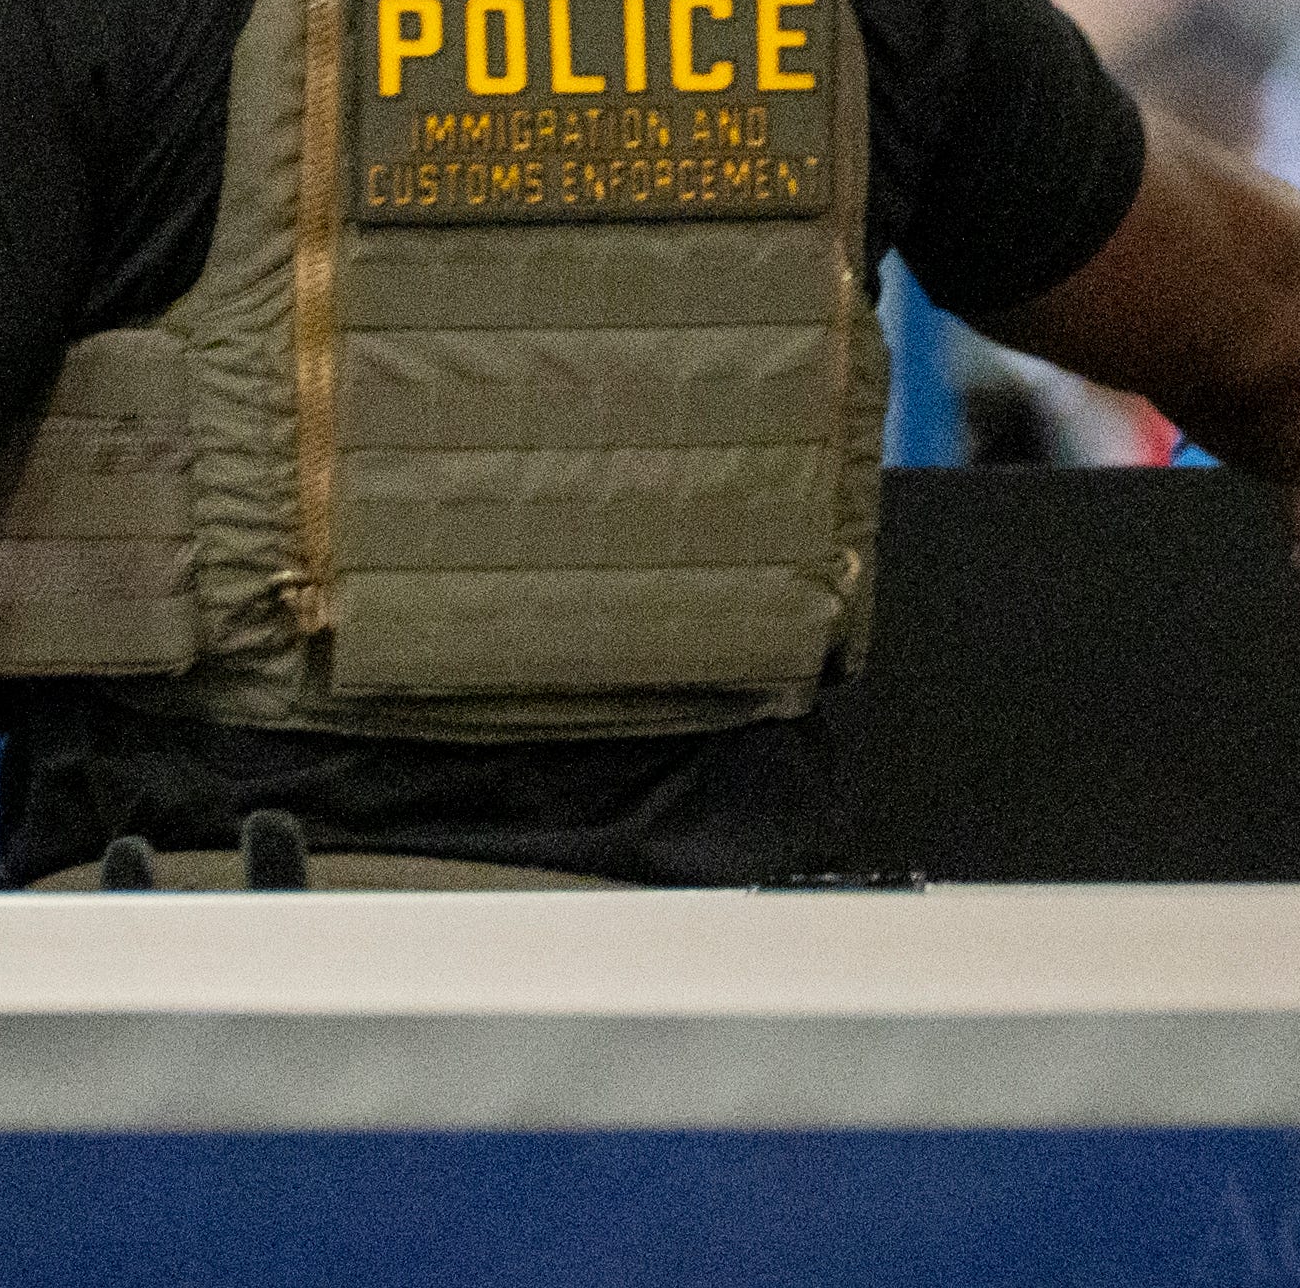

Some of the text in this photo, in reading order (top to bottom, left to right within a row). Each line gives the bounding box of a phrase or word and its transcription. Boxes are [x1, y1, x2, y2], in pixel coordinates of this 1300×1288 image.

[411, 108, 767, 153] IMMIGRATION AND
[367, 156, 820, 207] CUSTOMS ENFORCEMENT
